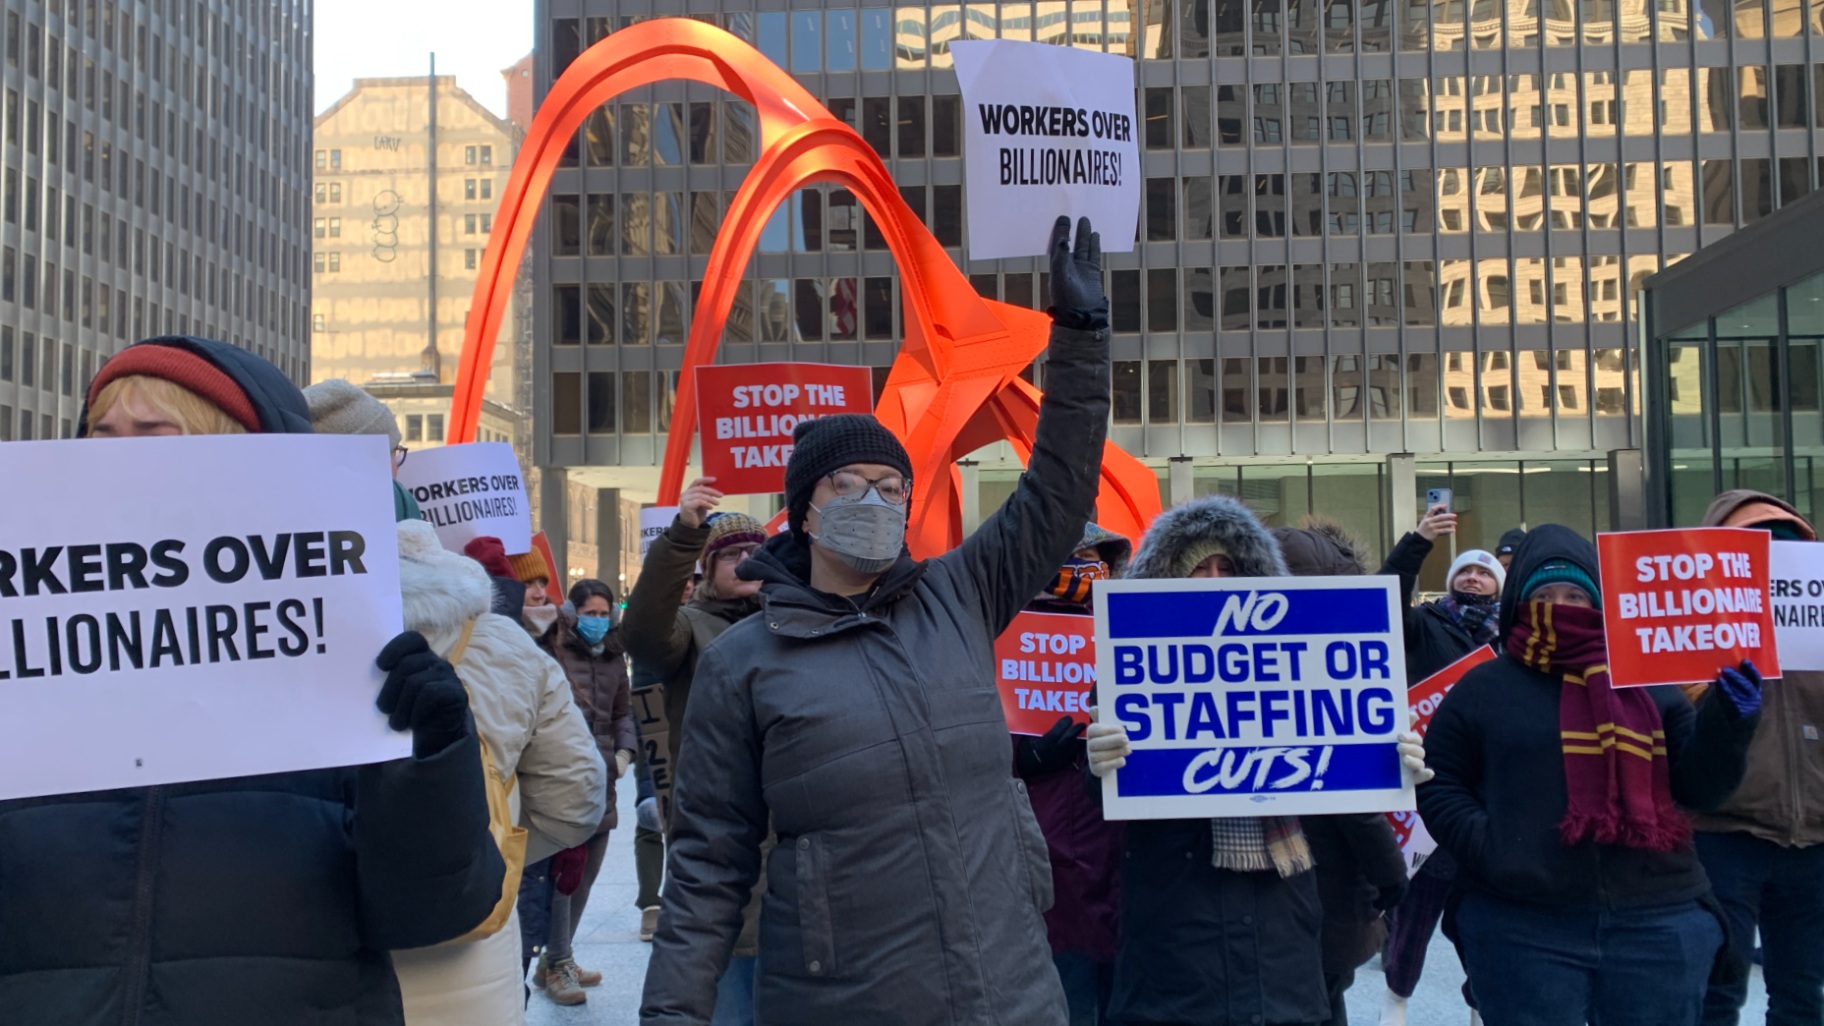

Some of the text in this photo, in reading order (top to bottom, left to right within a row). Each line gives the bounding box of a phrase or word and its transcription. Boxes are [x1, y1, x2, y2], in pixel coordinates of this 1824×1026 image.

[979, 104, 1131, 142] WORKERS OVER
[1000, 148, 1122, 186] BILLIONAIRES!
[733, 384, 846, 408] STOP THE
[716, 414, 834, 439] BILLIO
[730, 444, 795, 468] TAKE
[409, 475, 519, 503] ORKERS OVER
[0, 530, 368, 598] RKERS OVER
[1635, 552, 1752, 583] STOP THE
[1211, 589, 1289, 637] NO
[1618, 587, 1763, 619] BILLIONAIRE
[0, 597, 326, 680] LIONAIRES!
[1020, 632, 1085, 655] STOP
[1635, 622, 1761, 654] TAKEOVER
[1002, 658, 1096, 683] BILLION
[1114, 640, 1391, 685] BUDGET OR
[1014, 688, 1090, 713] TAKEO
[1115, 688, 1395, 742] STAFFING
[1408, 692, 1443, 720] TOP
[1182, 745, 1333, 793] CUTS!
